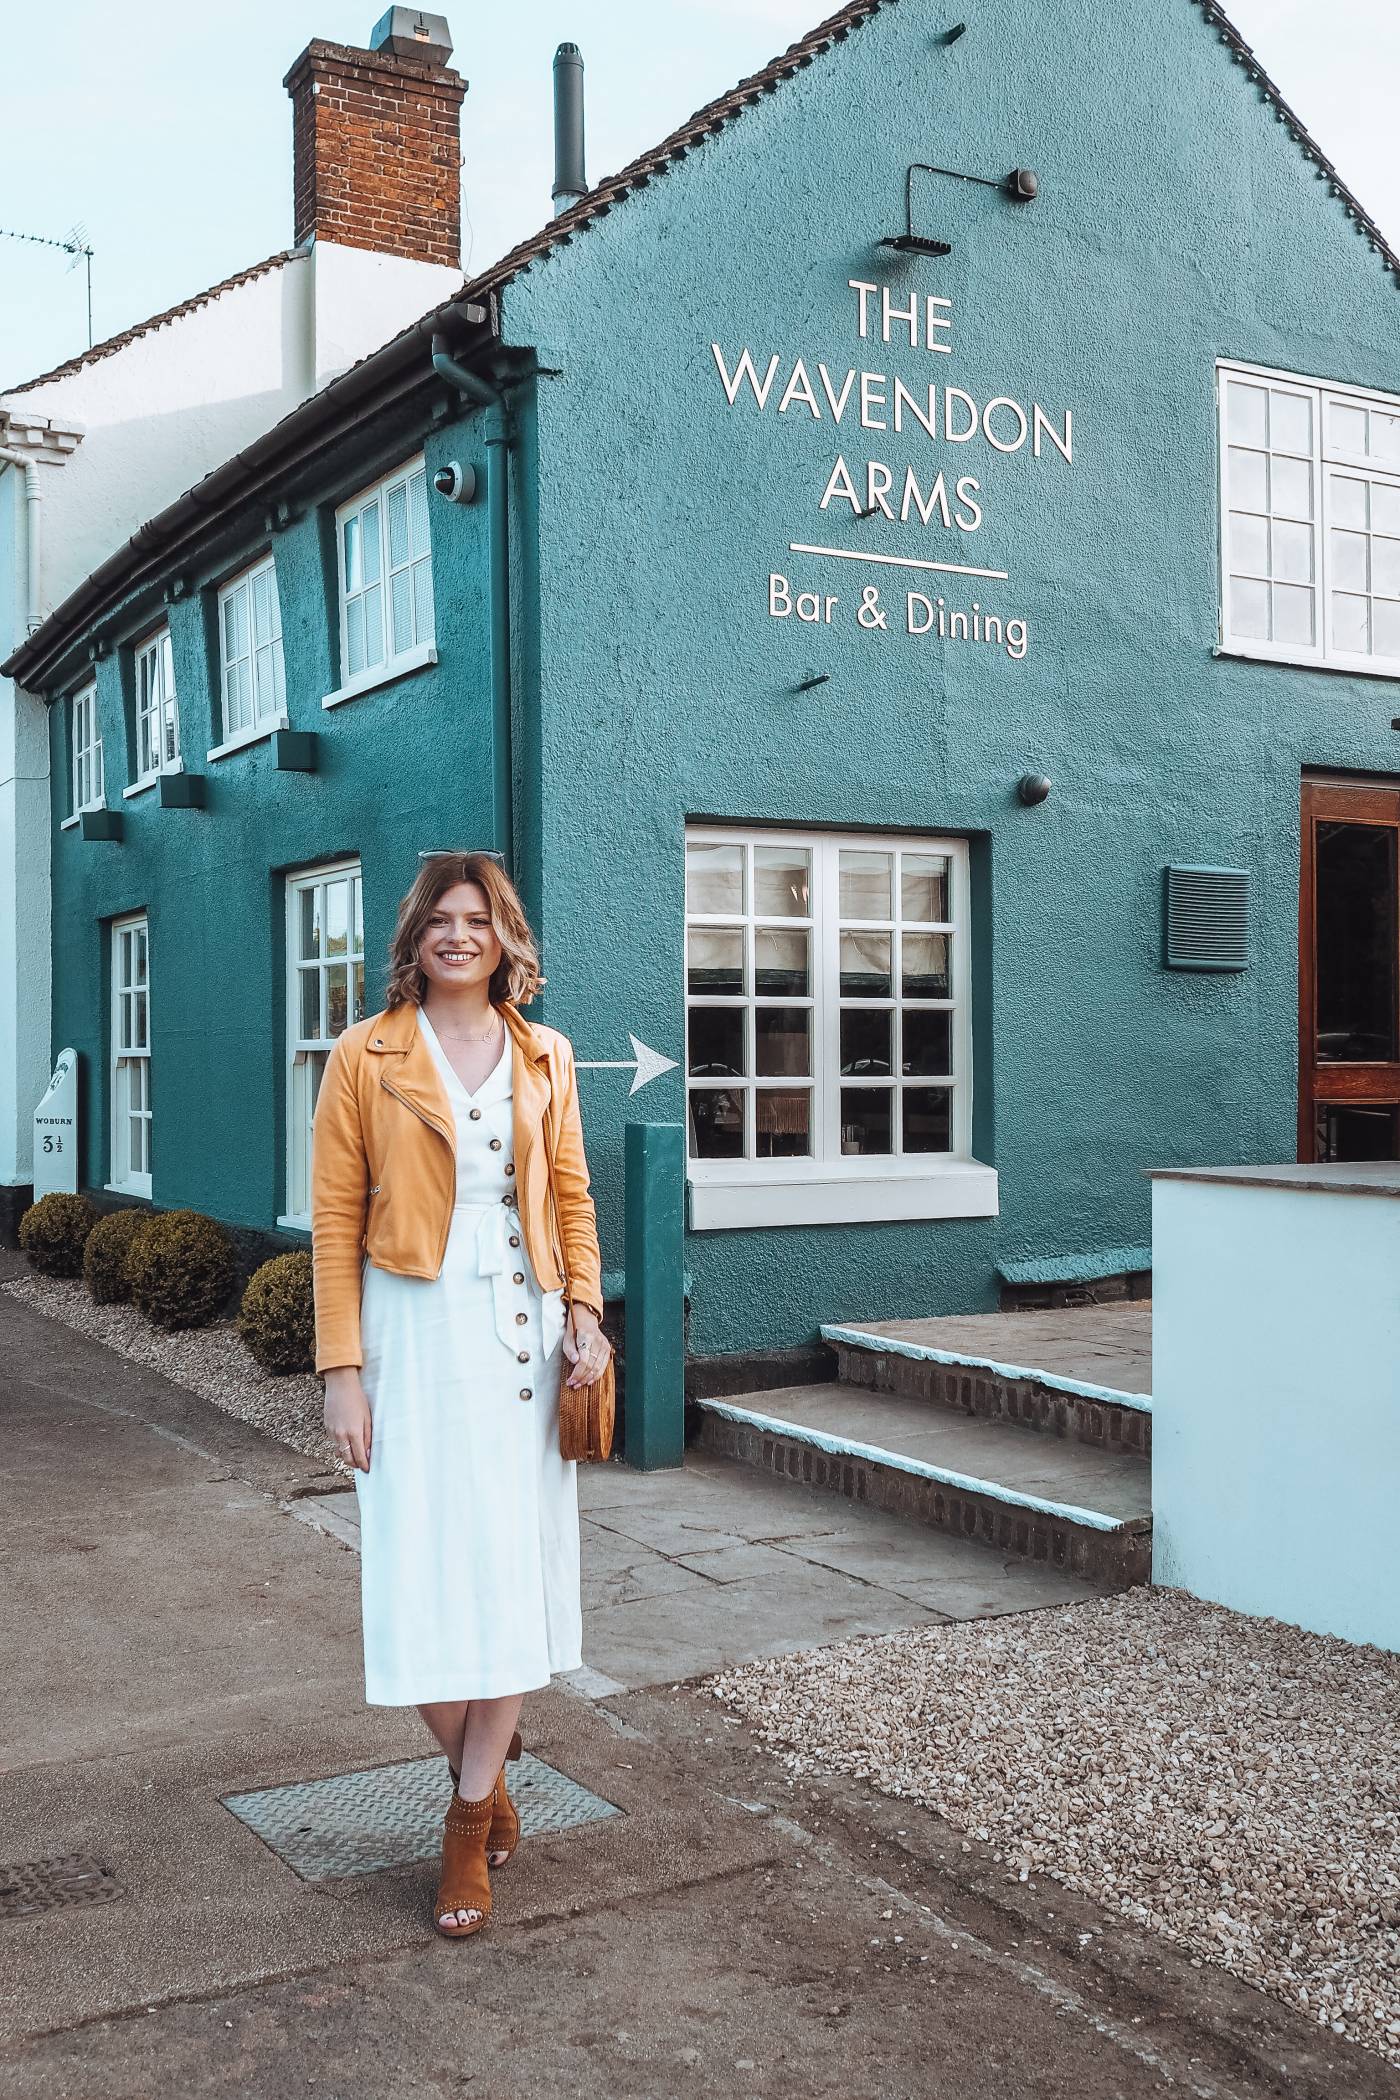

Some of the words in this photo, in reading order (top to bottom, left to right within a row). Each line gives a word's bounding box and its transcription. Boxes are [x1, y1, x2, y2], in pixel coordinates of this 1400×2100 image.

[848, 279, 952, 354] THE
[711, 343, 1073, 465] WAVENDON
[819, 454, 982, 532] ARMS
[768, 573, 838, 624] Bar
[856, 585, 887, 630] &
[907, 592, 1028, 659] Dining
[36, 1117, 73, 1125] WOBURN
